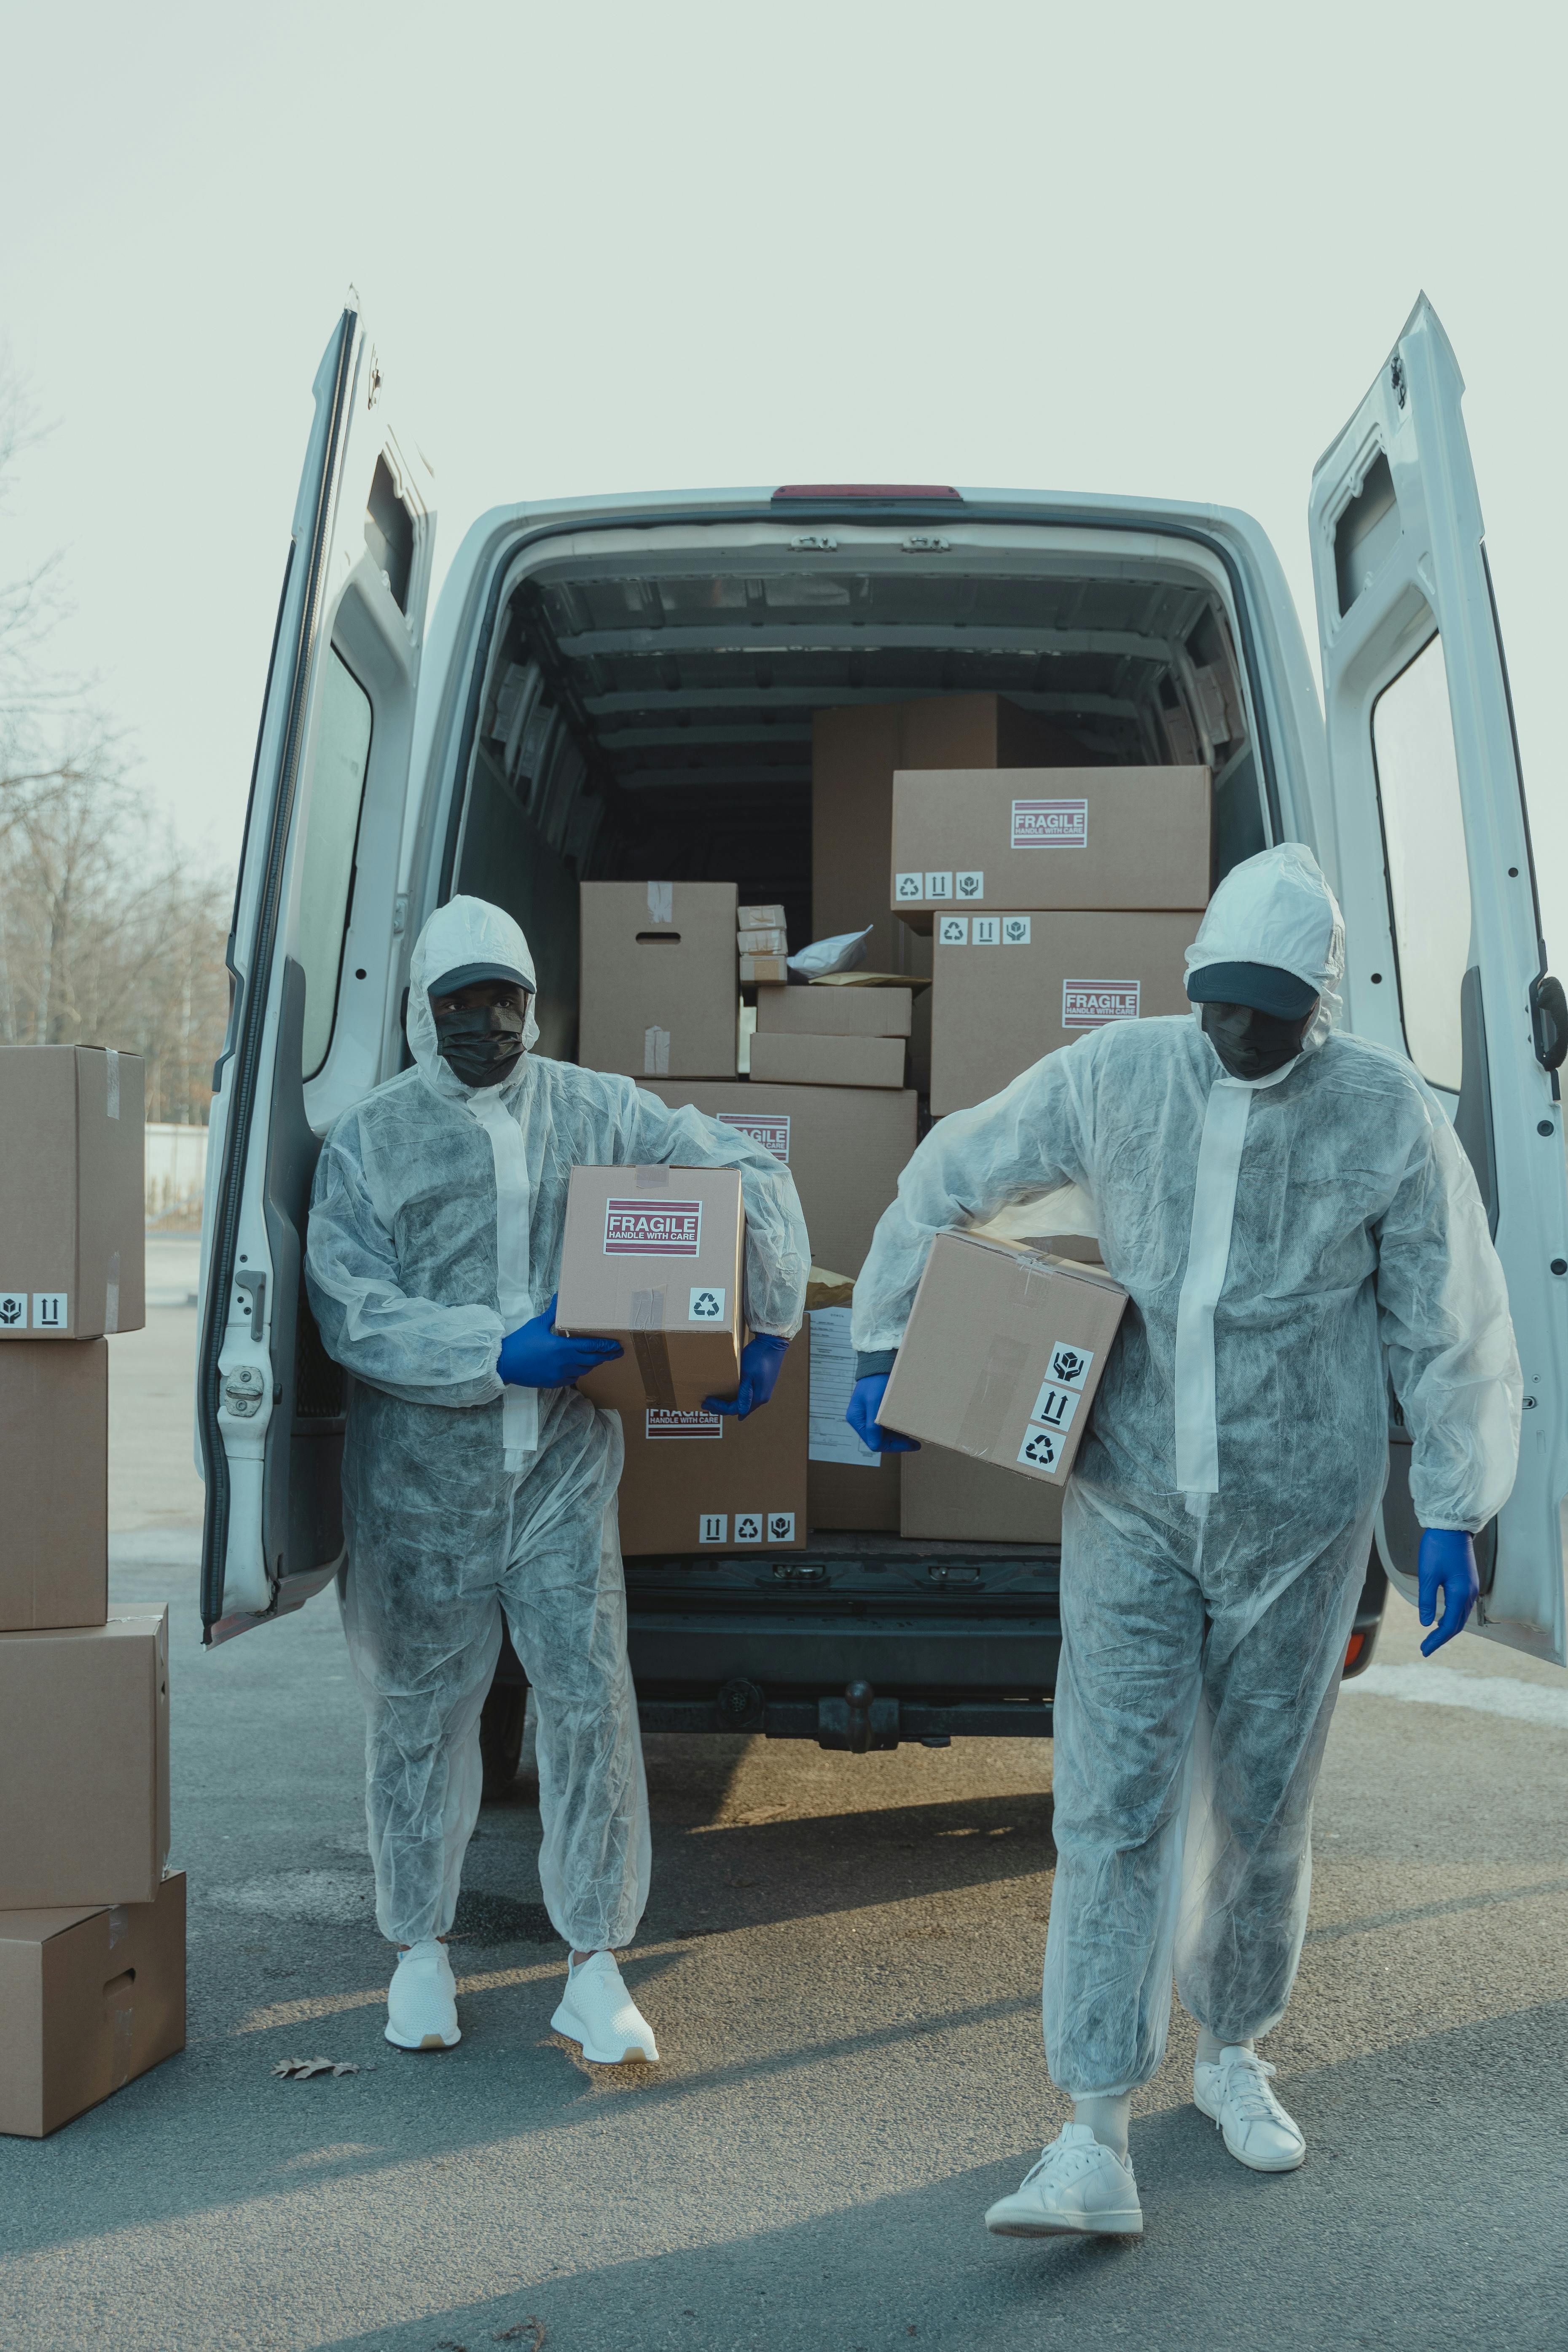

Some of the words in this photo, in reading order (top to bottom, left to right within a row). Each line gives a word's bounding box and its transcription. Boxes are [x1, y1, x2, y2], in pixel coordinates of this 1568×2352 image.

[1015, 814, 1084, 828] FRAGILE
[1066, 994, 1136, 1008] FRAGILE
[741, 1129, 786, 1143] GILE
[609, 1216, 696, 1233] FRAGILE
